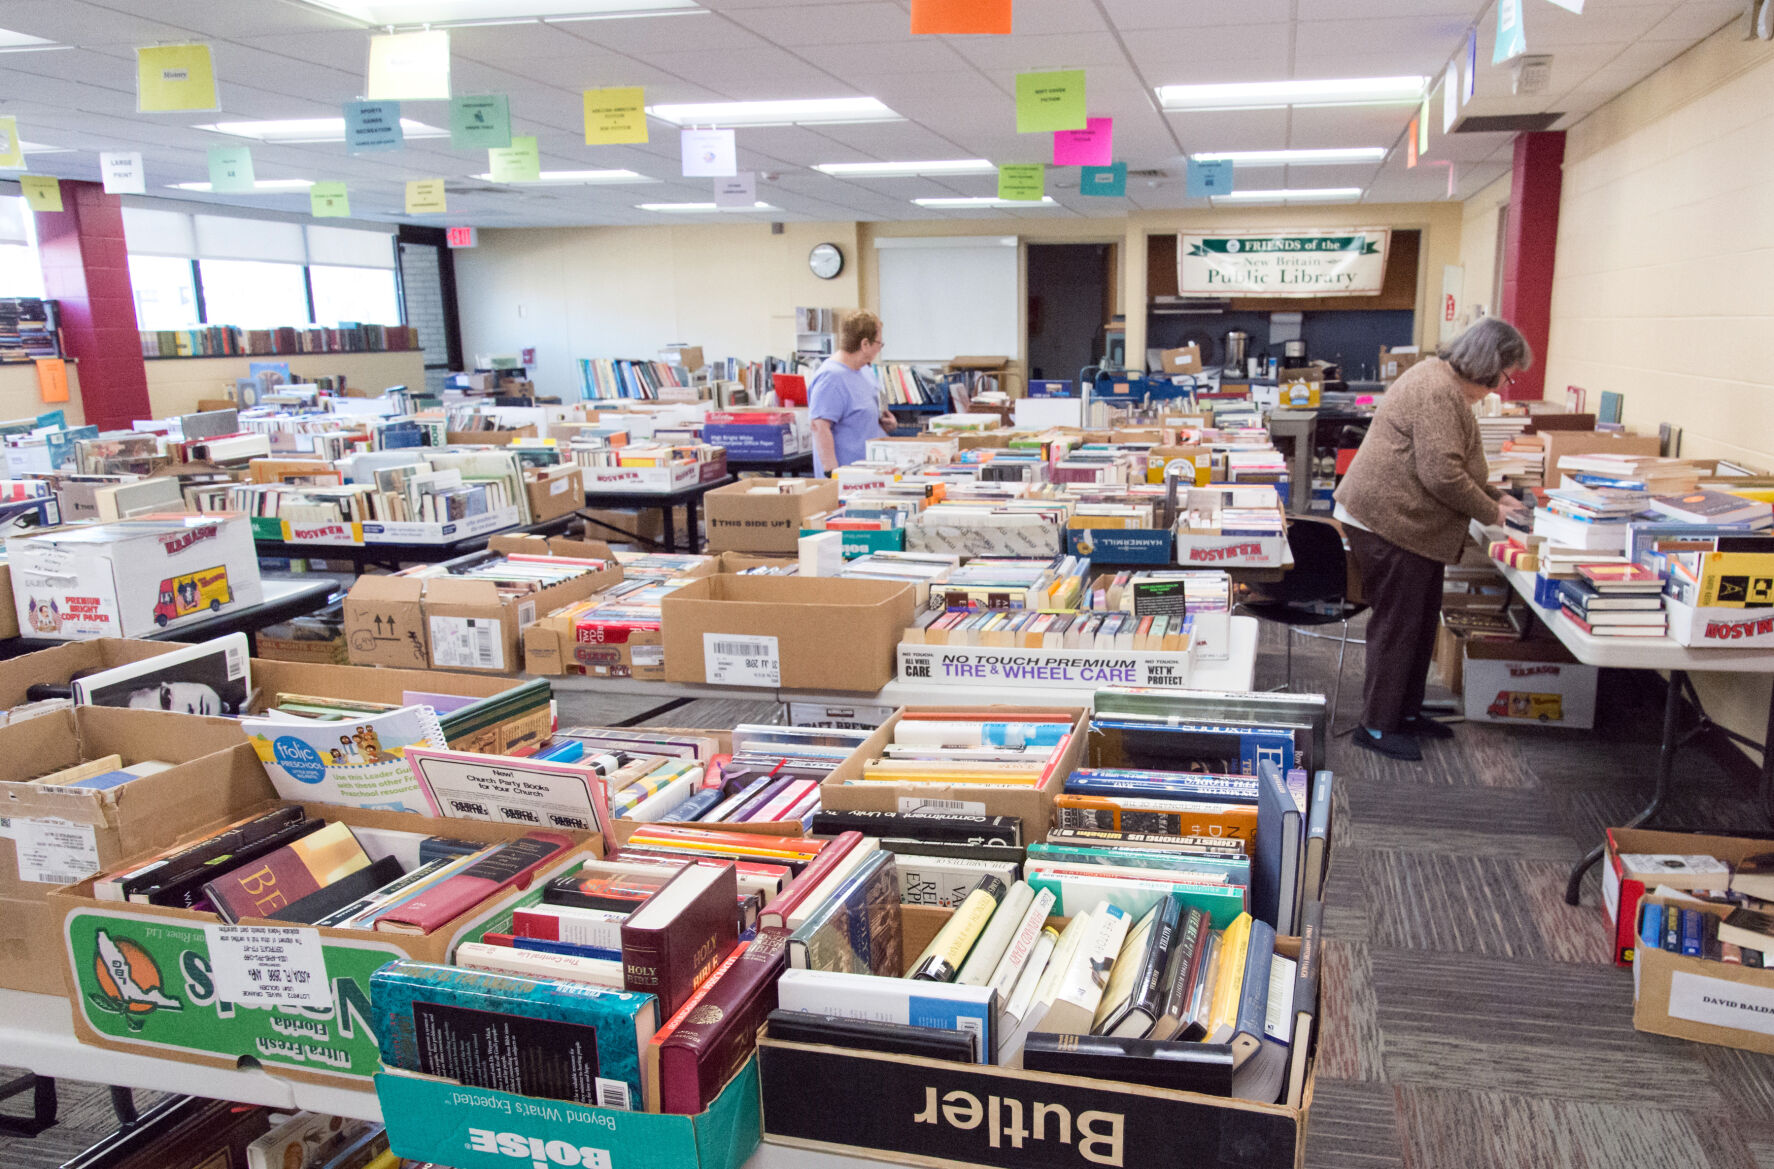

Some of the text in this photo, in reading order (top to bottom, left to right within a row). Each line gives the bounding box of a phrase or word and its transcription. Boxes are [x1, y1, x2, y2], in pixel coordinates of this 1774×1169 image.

[111, 159, 132, 167] LARGE
[113, 171, 133, 180] PRINT
[450, 226, 471, 247] EXIT
[1245, 238, 1340, 252] FRIENDS of the
[1243, 255, 1321, 268] New Britain
[1207, 268, 1360, 288] Public Library
[719, 519, 785, 528] THIS SIDE UP
[1102, 538, 1163, 547] HAMMERMILL
[65, 596, 101, 607] PREMIUM
[69, 604, 99, 615] BRIGHT
[61, 613, 110, 623] COPY PAPER
[905, 658, 930, 666] ALL WHEEL
[942, 654, 1136, 669] NO TOUCH PREMIUM
[904, 665, 932, 678] CARE
[942, 662, 1136, 682] TIRE & WHEEL CARE
[1147, 674, 1183, 686] PROTECT
[277, 740, 314, 767] frolic
[280, 758, 324, 771] PRESCHOOL
[333, 769, 393, 782] Use this Leader
[492, 768, 514, 779] New!
[337, 778, 403, 790] with these other
[467, 774, 550, 792] Church Party Books
[341, 788, 379, 799] Preschool
[479, 782, 543, 798] for Your Church
[451, 800, 482, 811] CHURCH
[456, 805, 488, 816] PARTIES
[501, 807, 532, 818] CHURCH
[506, 812, 539, 824] PARTIES
[834, 807, 986, 825] Commitment to Unity
[550, 814, 582, 826] CHURCH
[1077, 830, 1122, 841] Wilhelm
[1130, 833, 1147, 843] US
[1149, 834, 1194, 846] AMONG
[1196, 837, 1238, 848] CHRIST
[1158, 925, 1171, 951] MATTHEW
[693, 932, 718, 967] HOLY
[515, 949, 581, 967] The Central Lie
[627, 965, 658, 977] HOLY
[627, 975, 659, 987] BIBLE
[241, 990, 282, 999] NAVEL ORANGE
[1703, 995, 1737, 1009] DAVID
[273, 1016, 328, 1036] Florida
[258, 1036, 351, 1064] Ultra Fresh
[514, 1102, 563, 1124] What's
[566, 1109, 617, 1132] Beyond
[914, 1086, 1126, 1169] Butler
